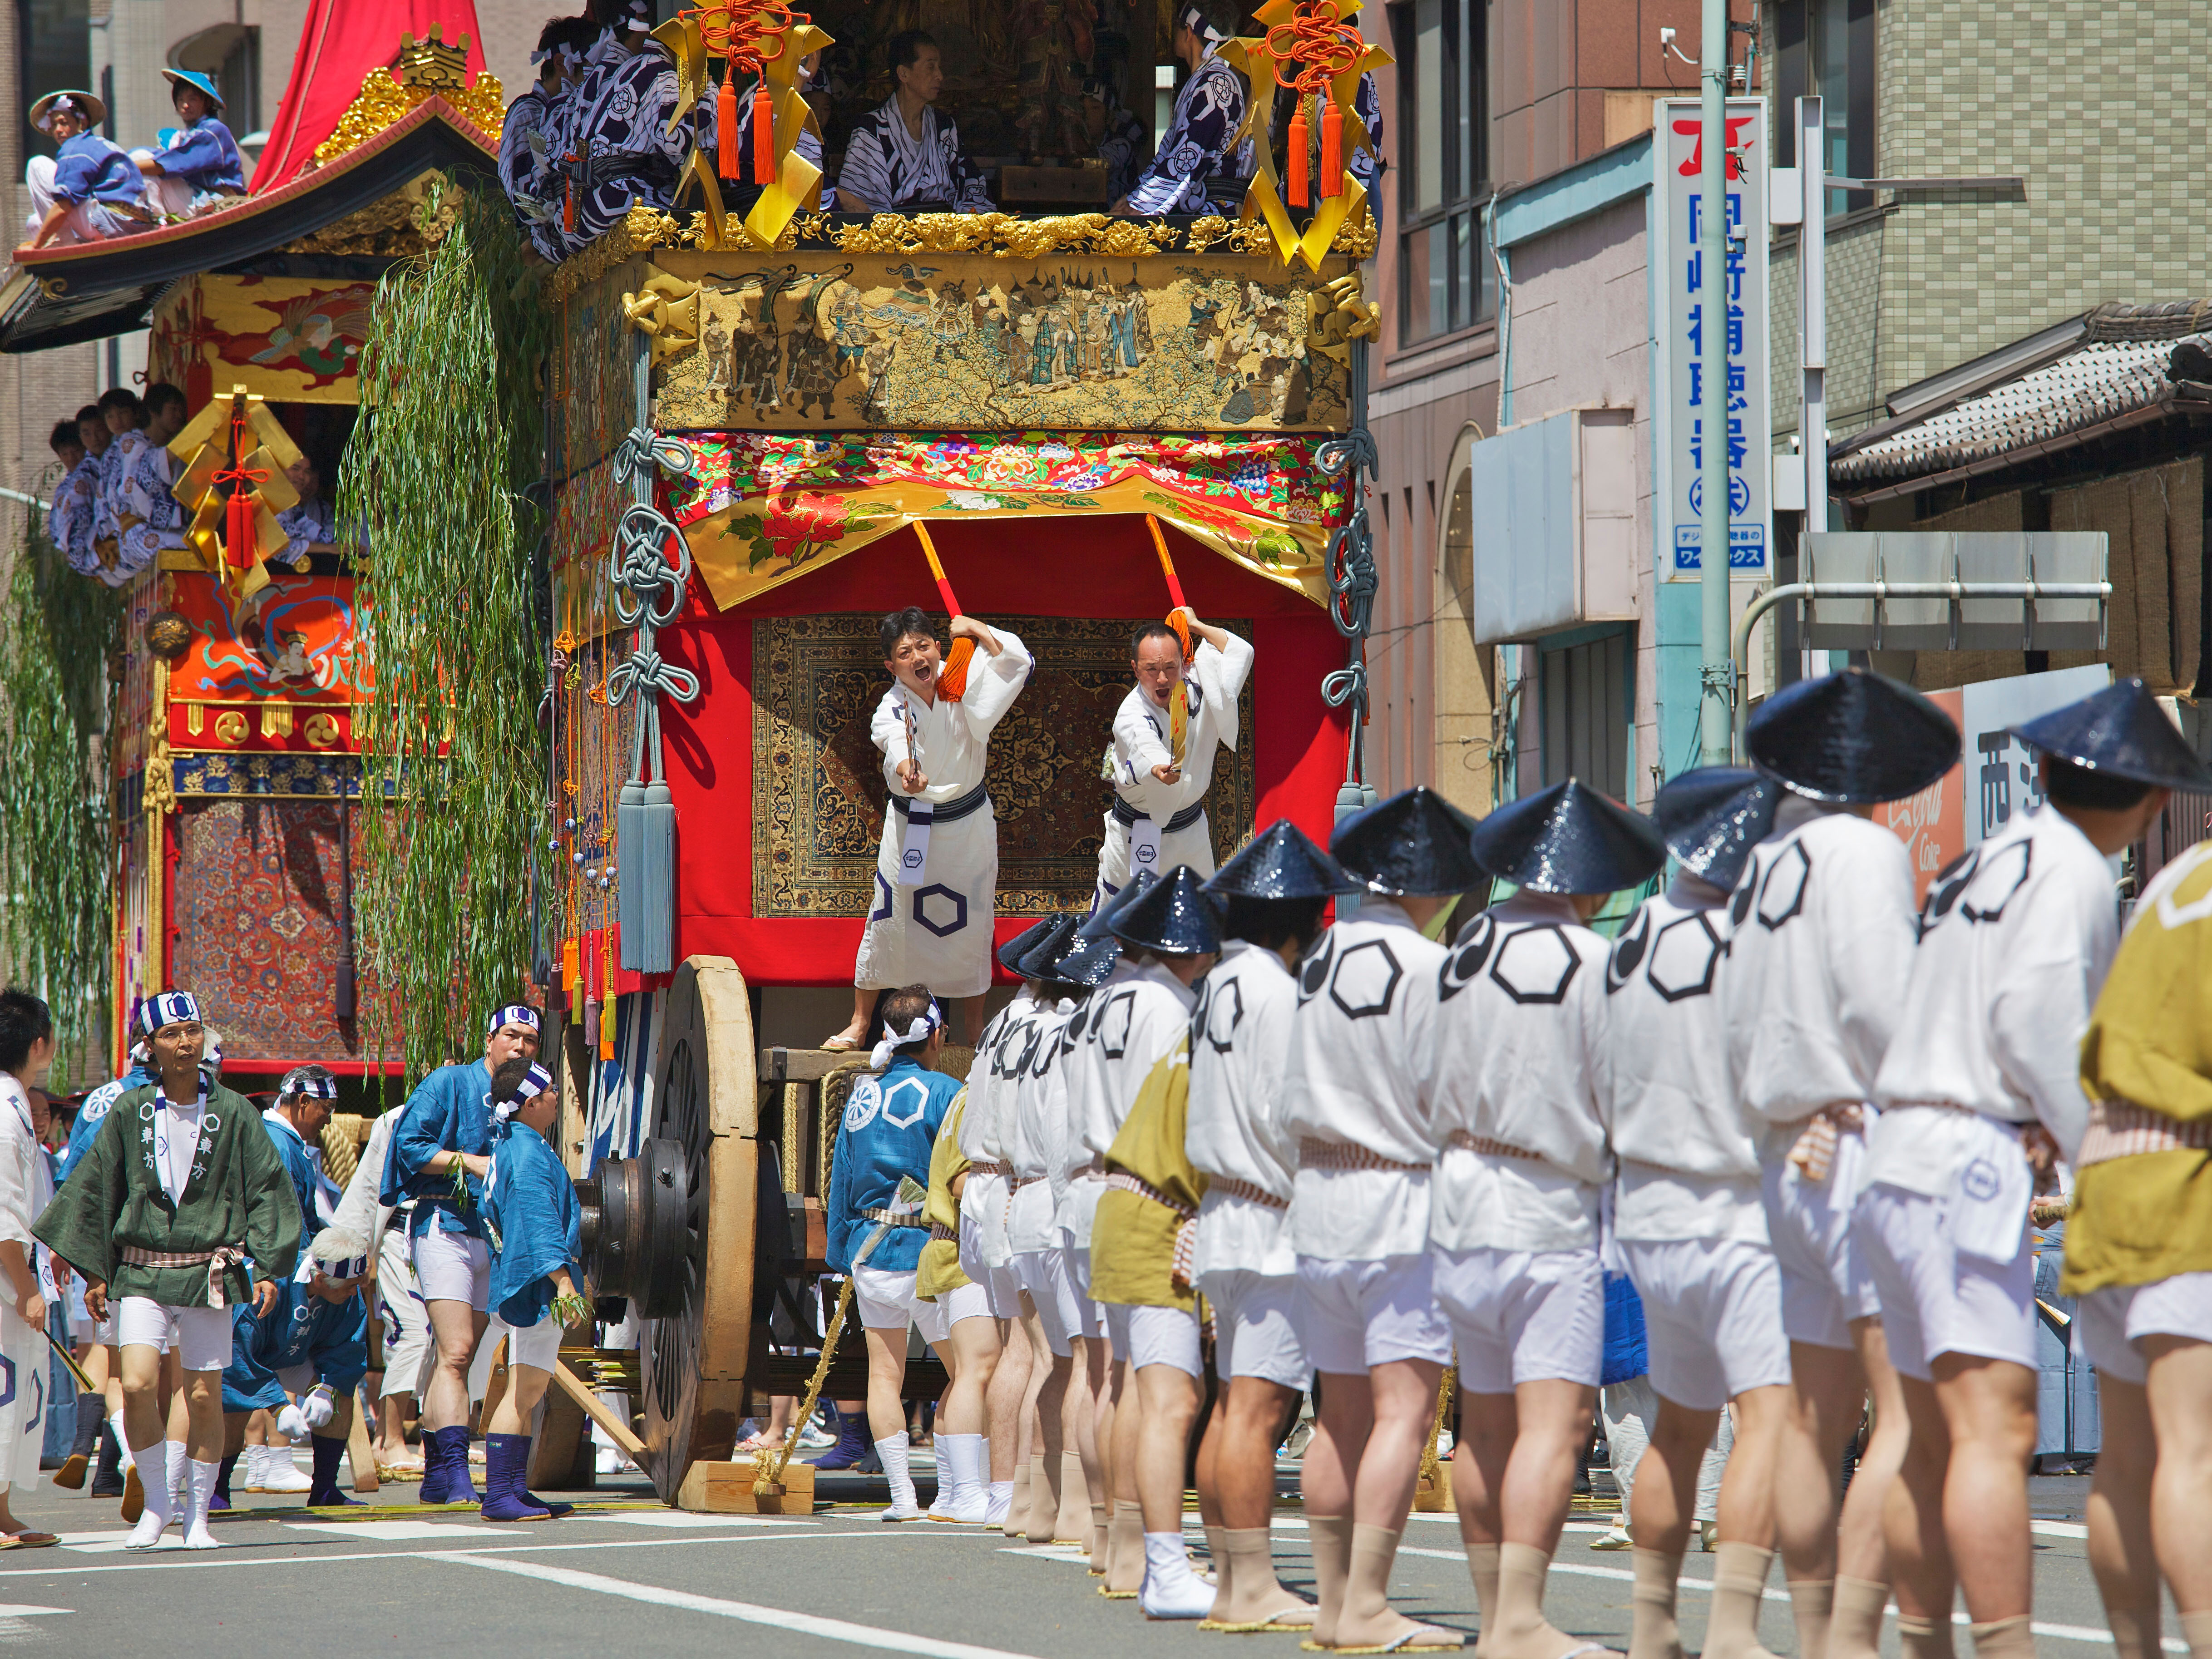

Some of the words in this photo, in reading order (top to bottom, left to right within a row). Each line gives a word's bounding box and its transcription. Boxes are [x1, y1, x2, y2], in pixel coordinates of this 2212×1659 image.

[1681, 531, 1760, 542] デジ聴器の
[1681, 549, 1761, 564] ワイクス
[1919, 832, 1940, 871] Coke
[140, 1126, 155, 1170] 車方
[191, 1136, 212, 1180] 車方
